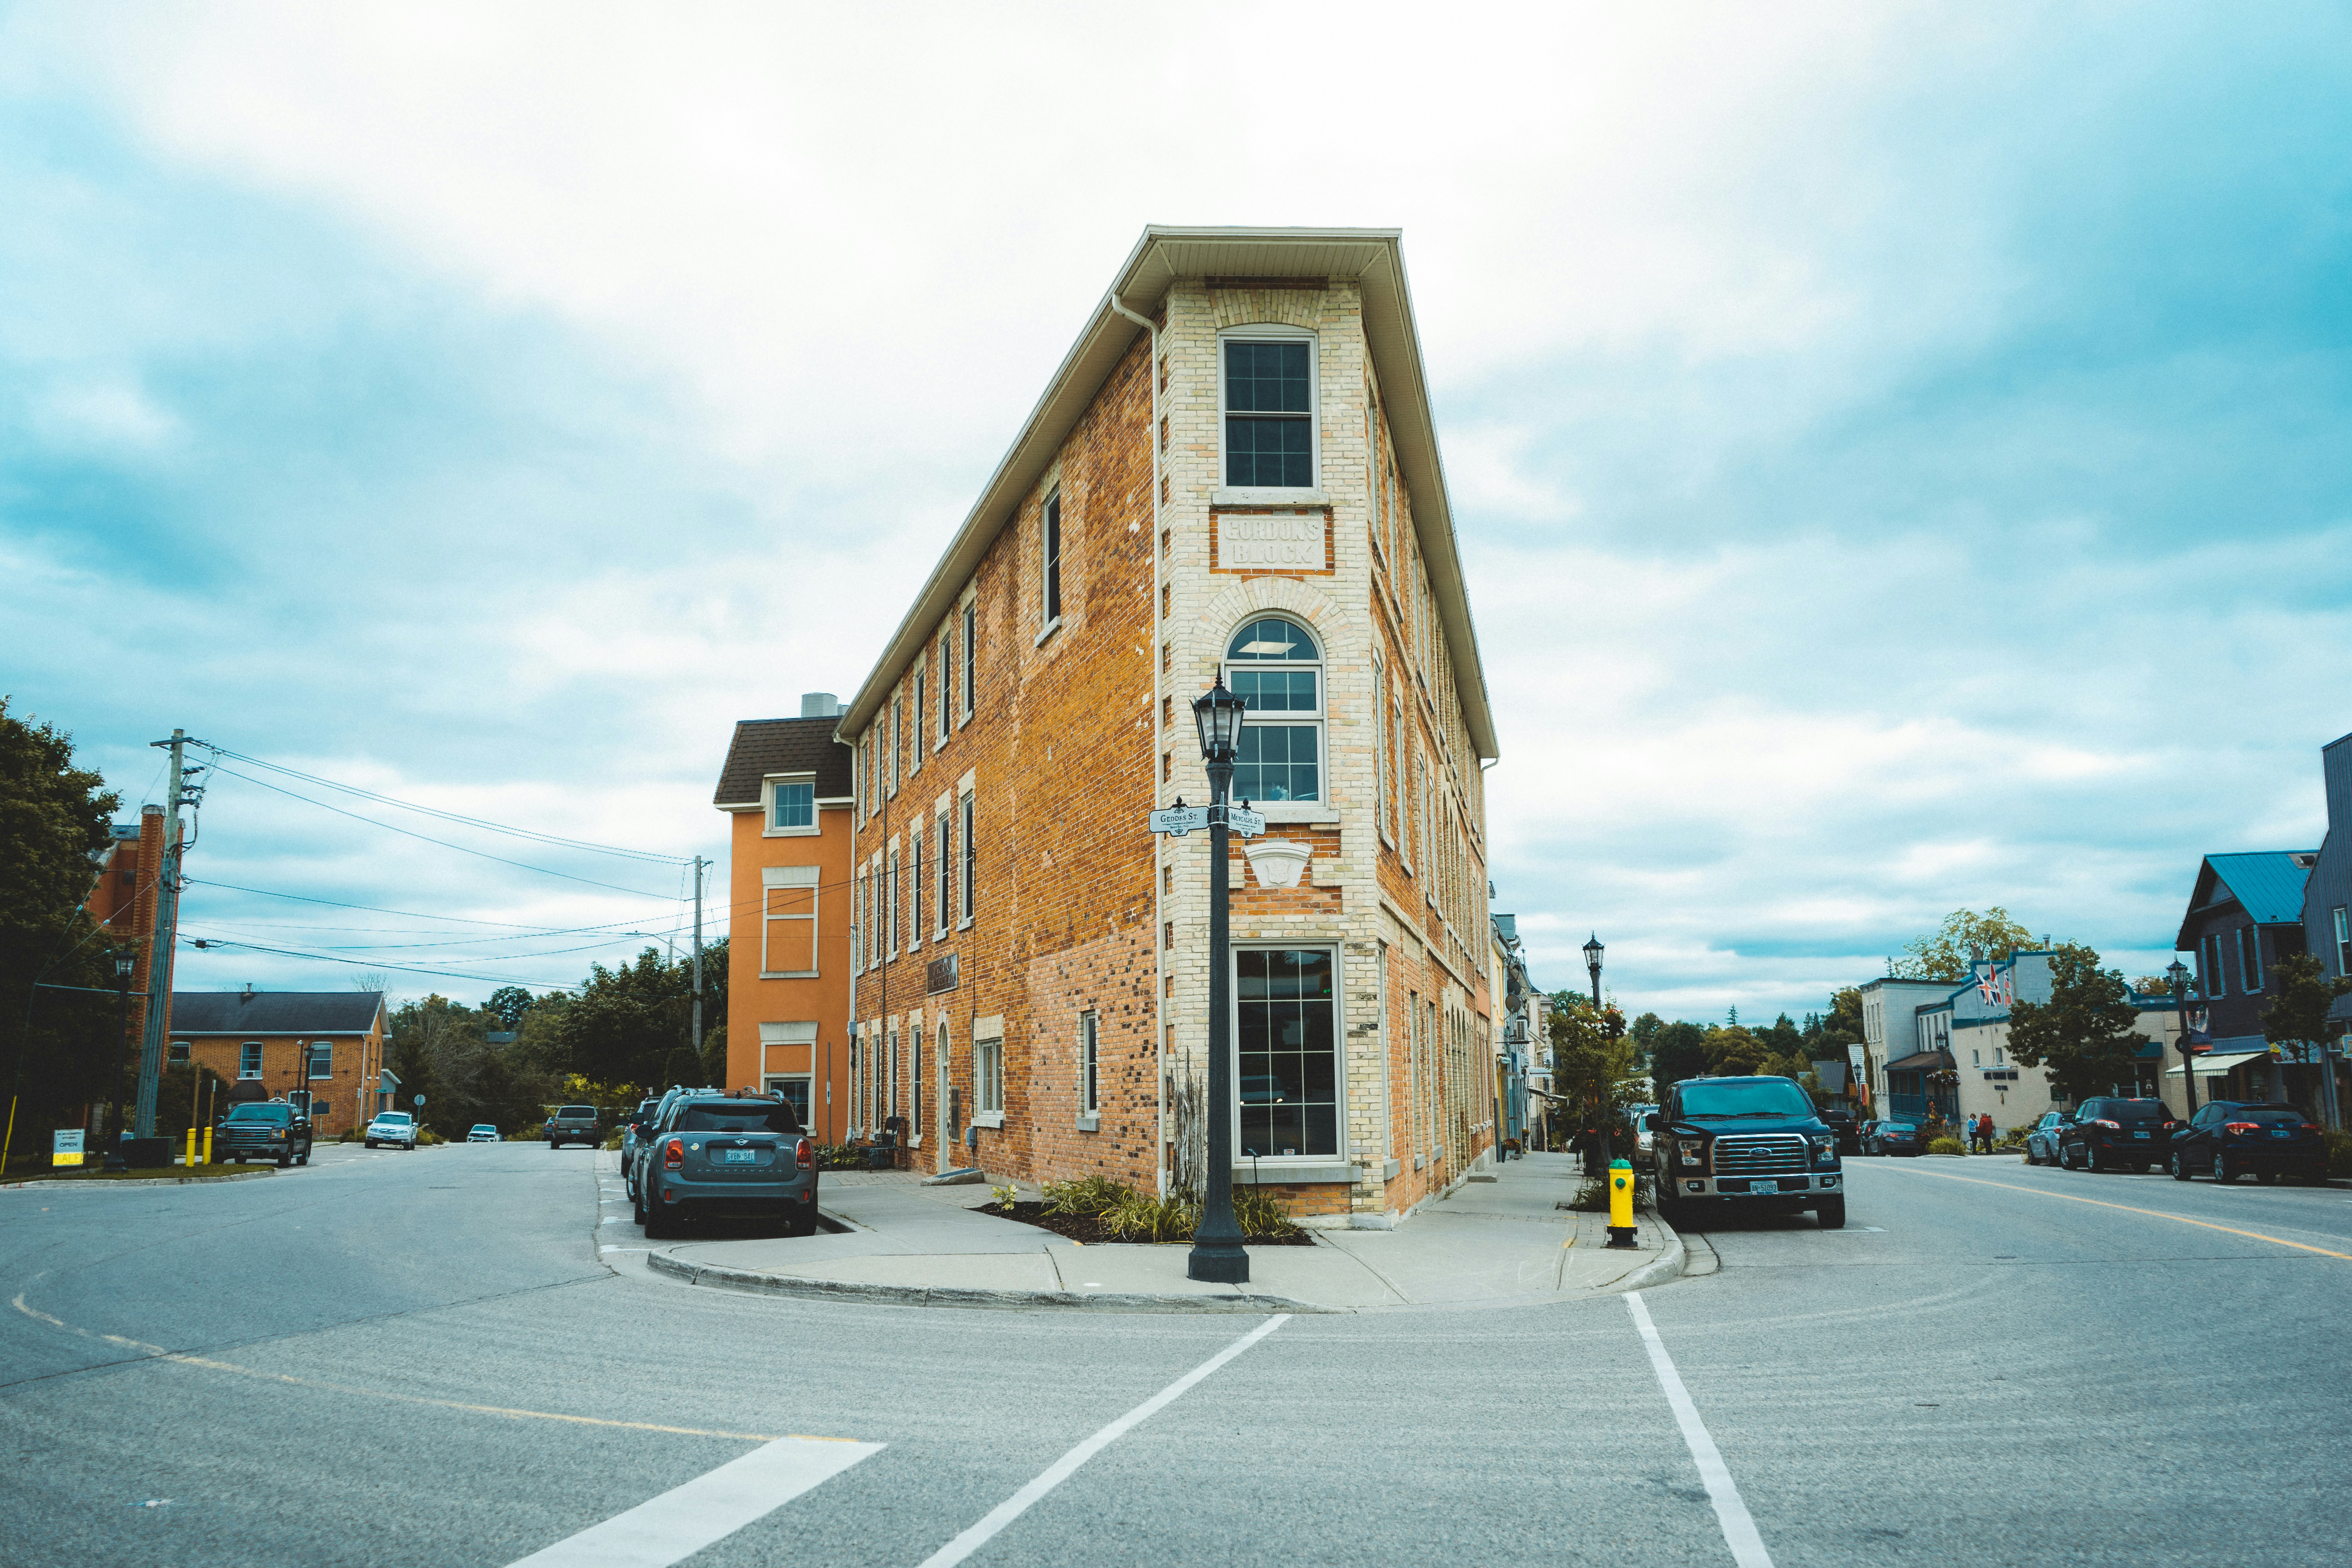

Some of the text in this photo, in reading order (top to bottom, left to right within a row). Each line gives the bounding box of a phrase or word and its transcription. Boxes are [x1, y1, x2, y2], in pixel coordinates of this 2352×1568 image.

[1224, 520, 1319, 541] GORDON'S
[1234, 544, 1312, 563] BLOCK
[1231, 813, 1253, 823] METCALFE
